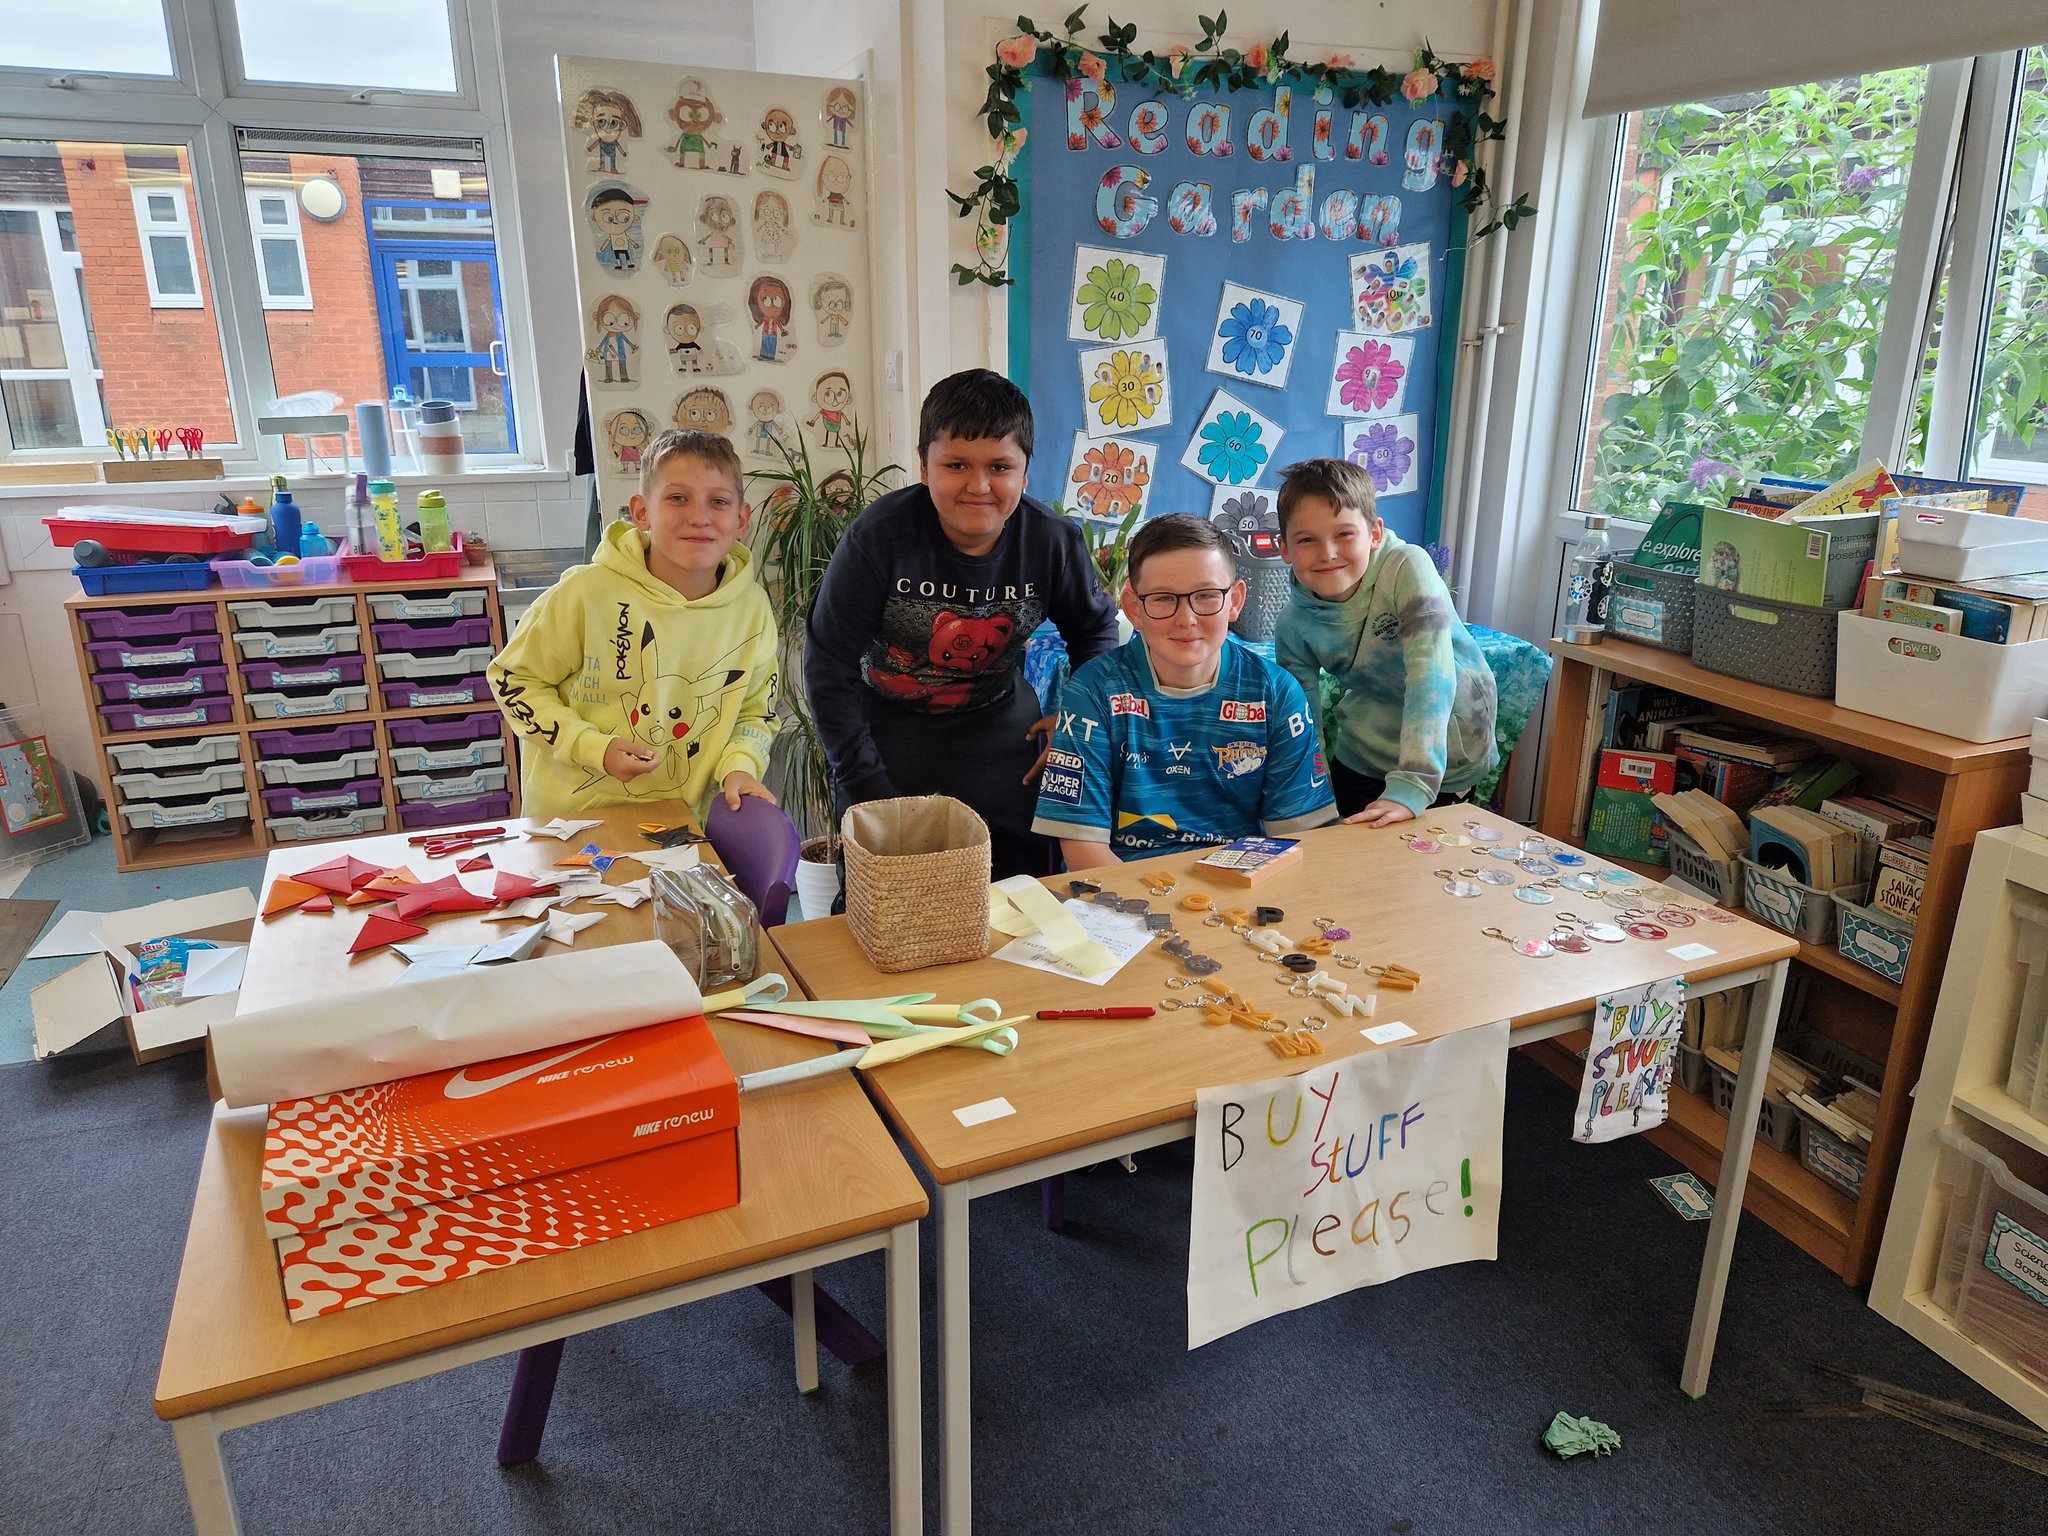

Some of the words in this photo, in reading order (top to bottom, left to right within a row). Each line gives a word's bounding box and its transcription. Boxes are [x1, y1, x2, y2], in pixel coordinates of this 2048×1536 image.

[1065, 79, 1445, 191] Reading
[1096, 163, 1401, 247] Garden
[1109, 291, 1125, 302] 40
[1250, 329, 1263, 341] 70
[1121, 381, 1135, 392] 30
[1228, 440, 1242, 452] 60
[1376, 449, 1389, 459] 80
[1105, 473, 1118, 484] 20
[1242, 520, 1254, 530] 50
[896, 578, 1036, 603] COUTURE
[1896, 640, 1941, 656] Towers
[1653, 697, 1678, 708] WILD
[1638, 706, 1689, 723] ANIMALS
[1166, 765, 1191, 775] OXEN
[1863, 824, 1880, 841] Five
[1905, 876, 1917, 886] THE
[1880, 890, 1908, 912] STONE
[1610, 998, 1673, 1041] BUY
[536, 1070, 571, 1085] NIKE
[573, 1055, 635, 1077] renew
[632, 1119, 663, 1138] NIKE
[663, 1107, 715, 1131] renew
[1222, 1071, 1339, 1172] BUY
